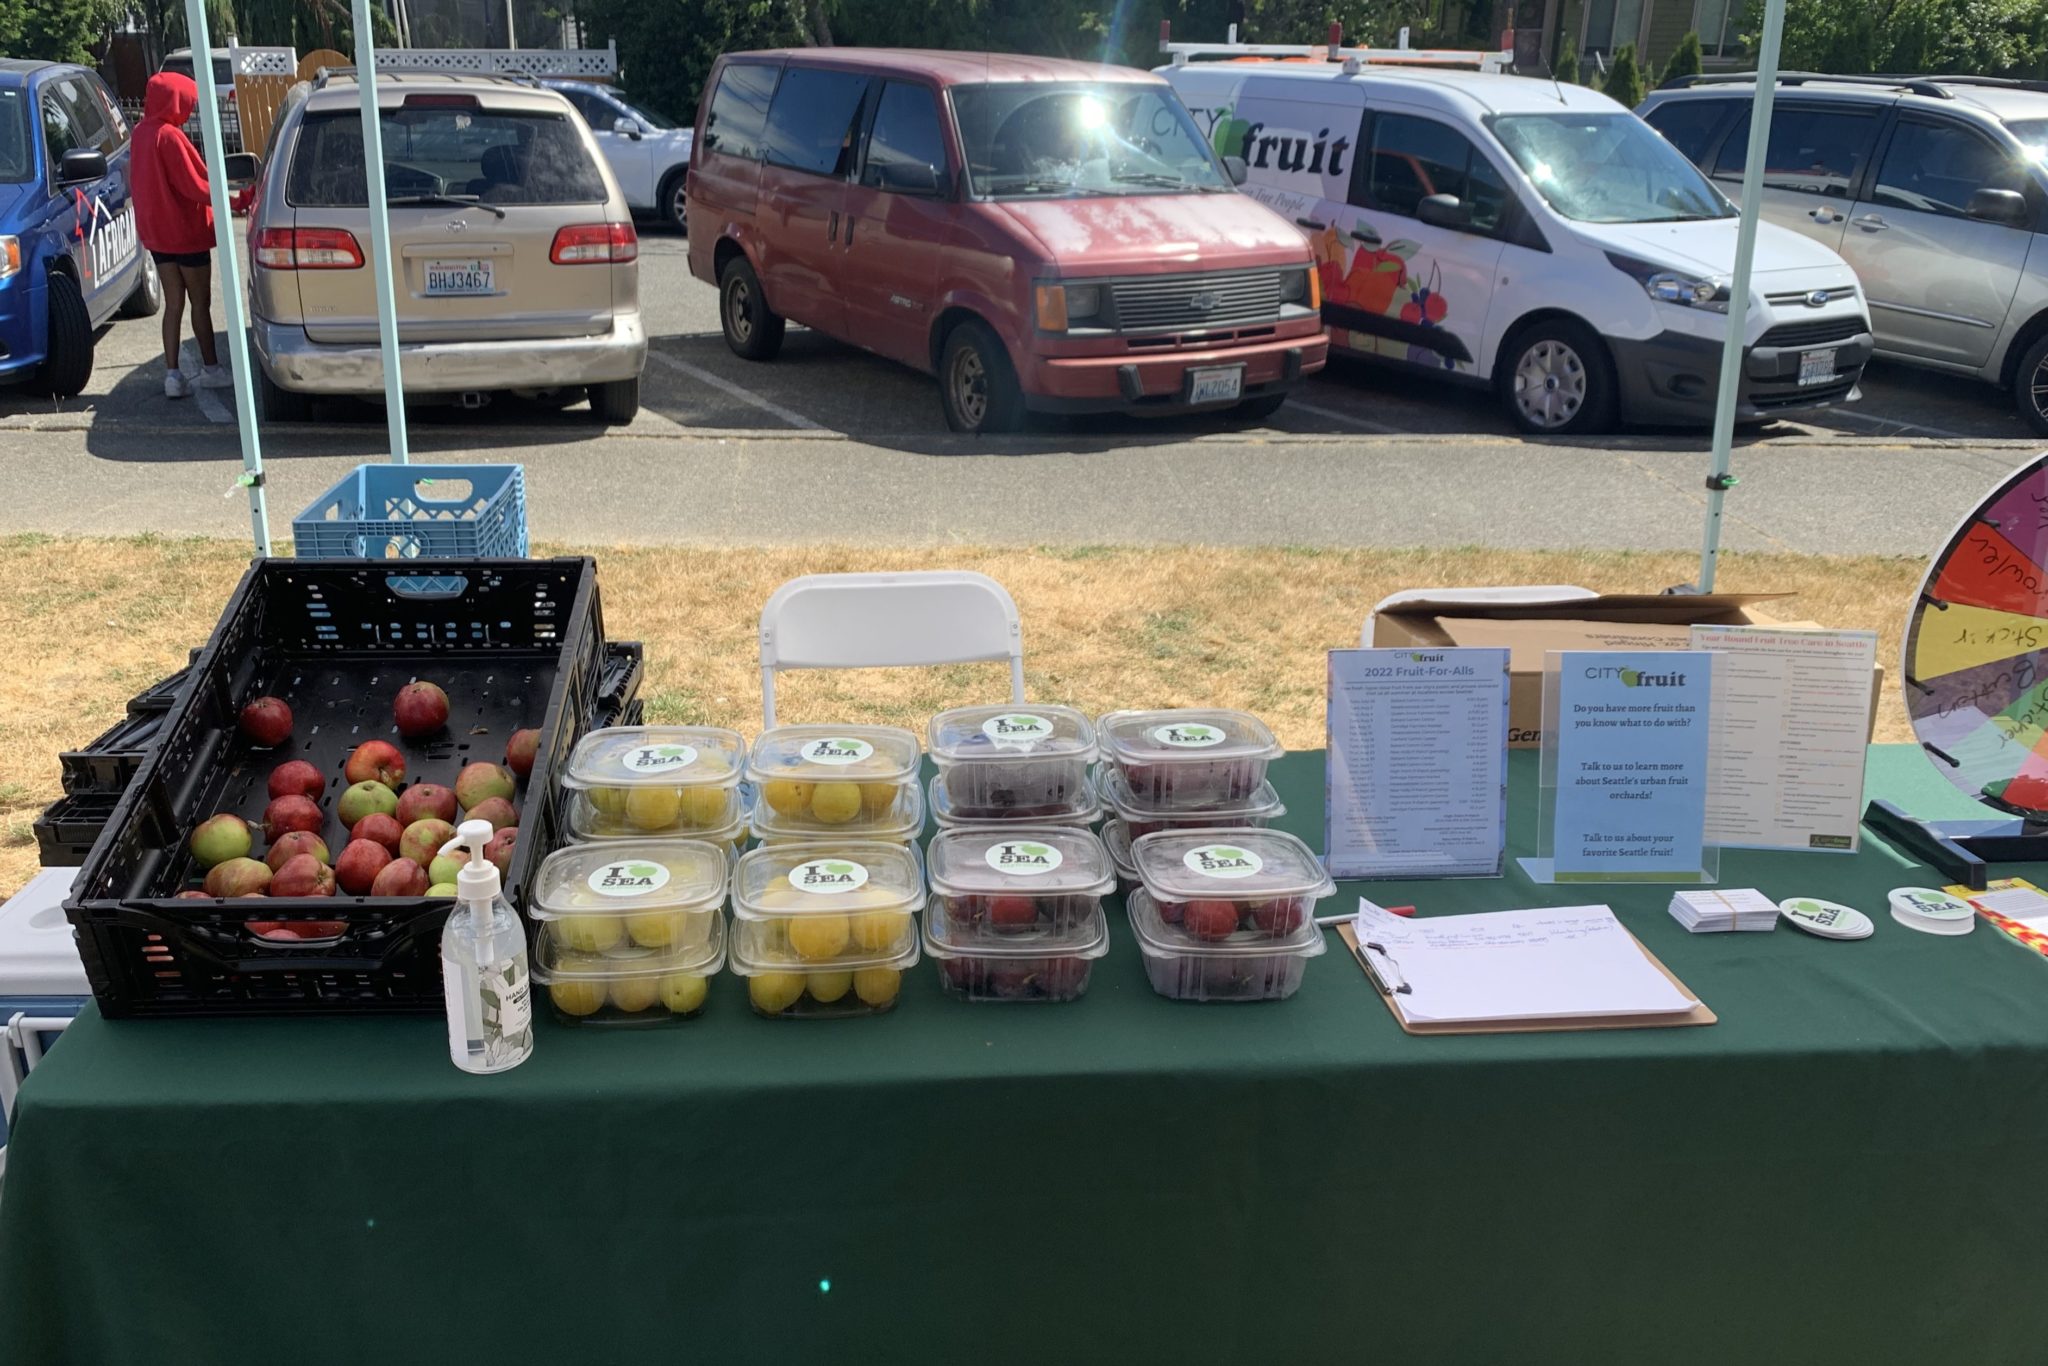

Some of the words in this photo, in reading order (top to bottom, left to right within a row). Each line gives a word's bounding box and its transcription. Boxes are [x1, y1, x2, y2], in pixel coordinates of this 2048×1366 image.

[1240, 122, 1350, 176] fruit
[429, 271, 490, 289] BHJ3467
[1969, 537, 2048, 599] rowler
[1418, 653, 1444, 663] fruit
[1364, 667, 1393, 677] 2022
[1395, 666, 1475, 677] Fruit-For-Alls
[1585, 667, 1625, 679] CITY
[1636, 671, 1686, 687] fruit
[1938, 659, 2036, 719] Button
[1574, 704, 1586, 712] Do
[1587, 706, 1604, 714] you
[1606, 704, 1626, 712] have
[1653, 703, 1673, 712] fruit
[1675, 704, 1696, 712] than
[994, 718, 1009, 727] I
[997, 723, 1043, 733] SEA
[1575, 720, 1591, 729] you
[1593, 718, 1618, 727] know
[1620, 718, 1641, 727] what
[1643, 719, 1652, 727] to
[1654, 718, 1665, 727] do
[1667, 718, 1691, 727] with?
[1167, 729, 1181, 738] I
[1170, 733, 1215, 743] SEA
[817, 740, 832, 749] I
[639, 750, 654, 760] I
[812, 747, 862, 758] SEA
[635, 754, 685, 768] SEA
[1581, 762, 1600, 771] Talk
[1602, 763, 1612, 771] to
[1625, 763, 1634, 771] to
[1635, 762, 1658, 771] learn
[1575, 776, 1600, 785] about
[1602, 776, 1638, 785] Seattle's
[1640, 776, 1667, 785] urban
[1668, 776, 1688, 785] fruit
[1609, 791, 1653, 800] orchards!
[1583, 833, 1602, 842] Talk
[1604, 834, 1613, 842] to
[1626, 833, 1651, 842] about
[1653, 835, 1674, 844] your
[1000, 845, 1016, 856] I
[1196, 850, 1214, 861] I
[1582, 848, 1617, 857] favorite
[1619, 848, 1648, 857] Seattle
[1650, 848, 1674, 857] fruit!
[999, 854, 1049, 865] SEA
[1200, 858, 1253, 870] SEA
[608, 867, 624, 878] I
[804, 865, 820, 876] I
[601, 876, 654, 888] SEA
[803, 873, 855, 885] SEA
[1900, 894, 1924, 905] I
[1919, 902, 1964, 912] SEA
[1791, 910, 1815, 922] I
[1815, 907, 1841, 927] SEA
